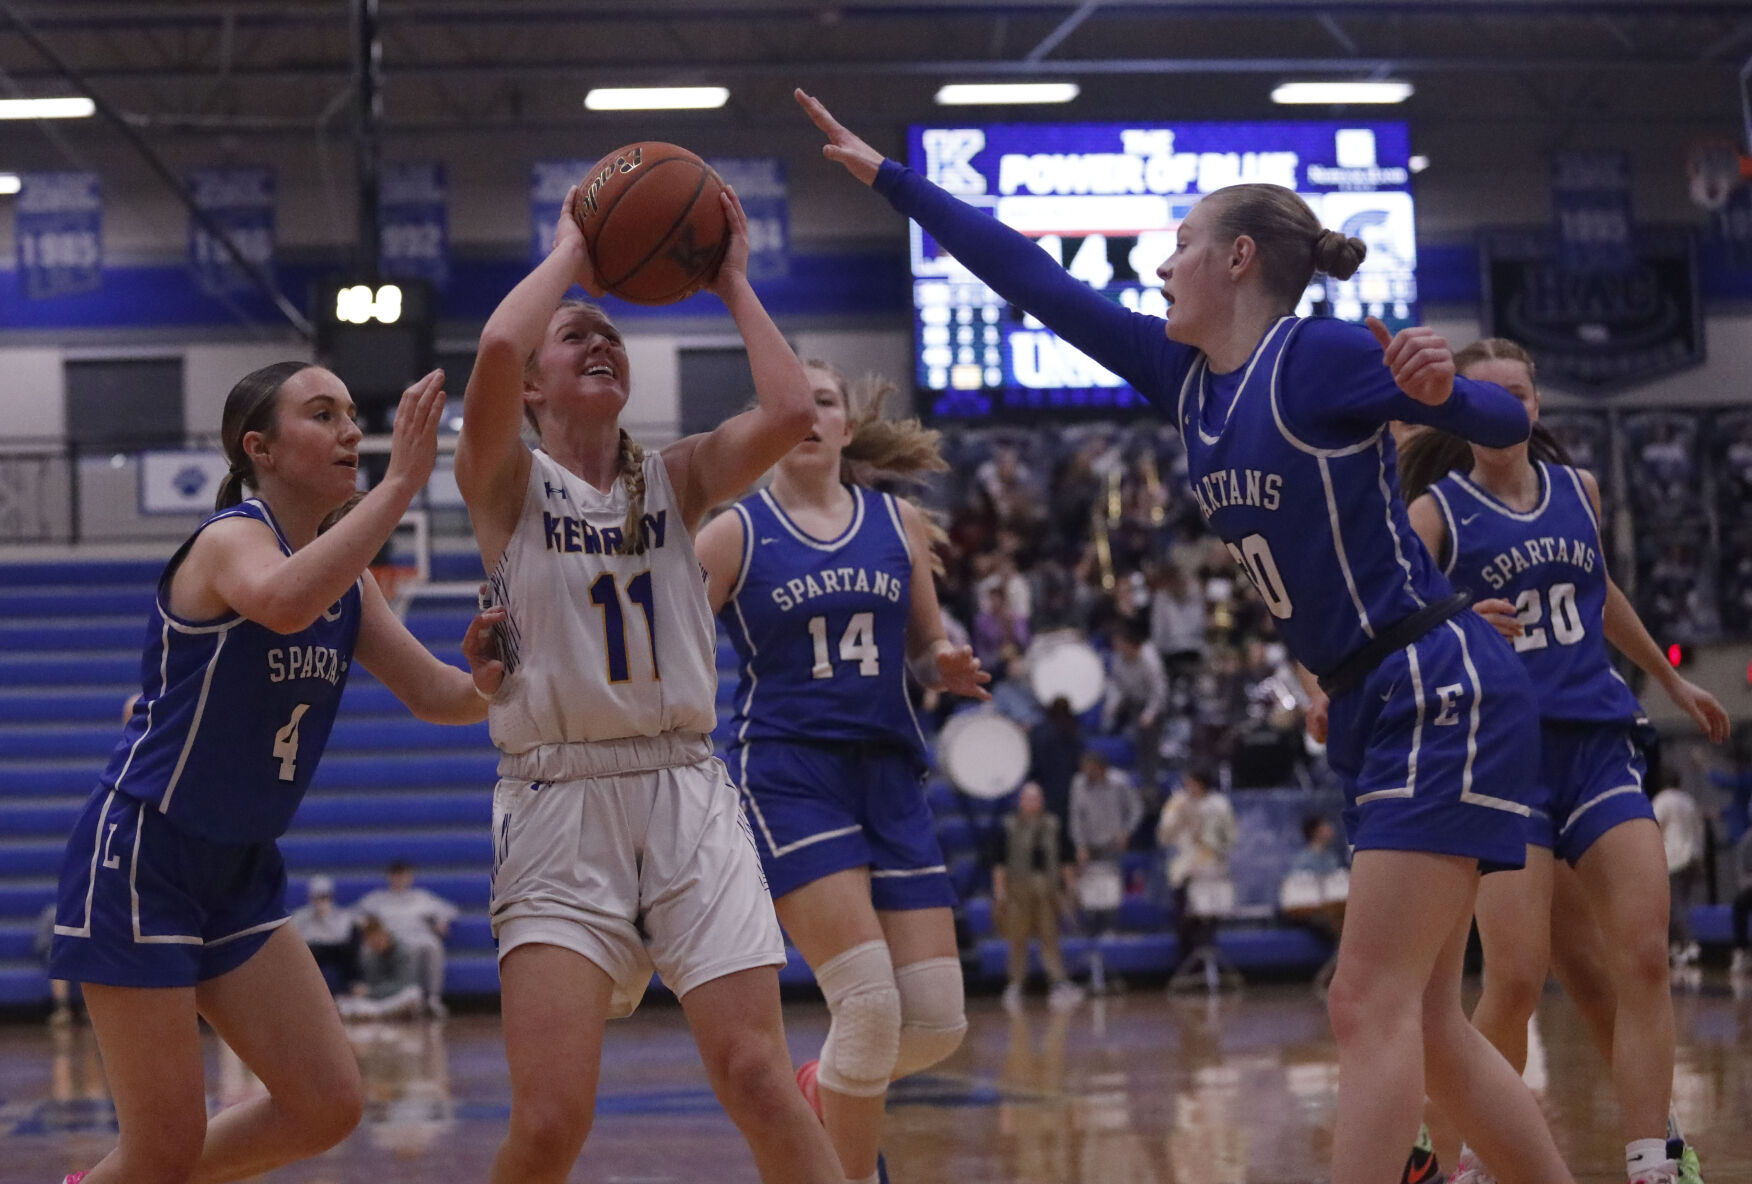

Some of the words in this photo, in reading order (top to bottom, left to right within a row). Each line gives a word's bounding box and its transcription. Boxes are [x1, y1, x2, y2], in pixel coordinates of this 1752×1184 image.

[771, 567, 901, 612] SPARTANS
[1481, 537, 1595, 590] SPARTANS
[588, 569, 660, 685] 11
[808, 611, 880, 679] 14
[1513, 582, 1586, 653] 20
[1433, 682, 1464, 727] E
[272, 703, 311, 782] 4
